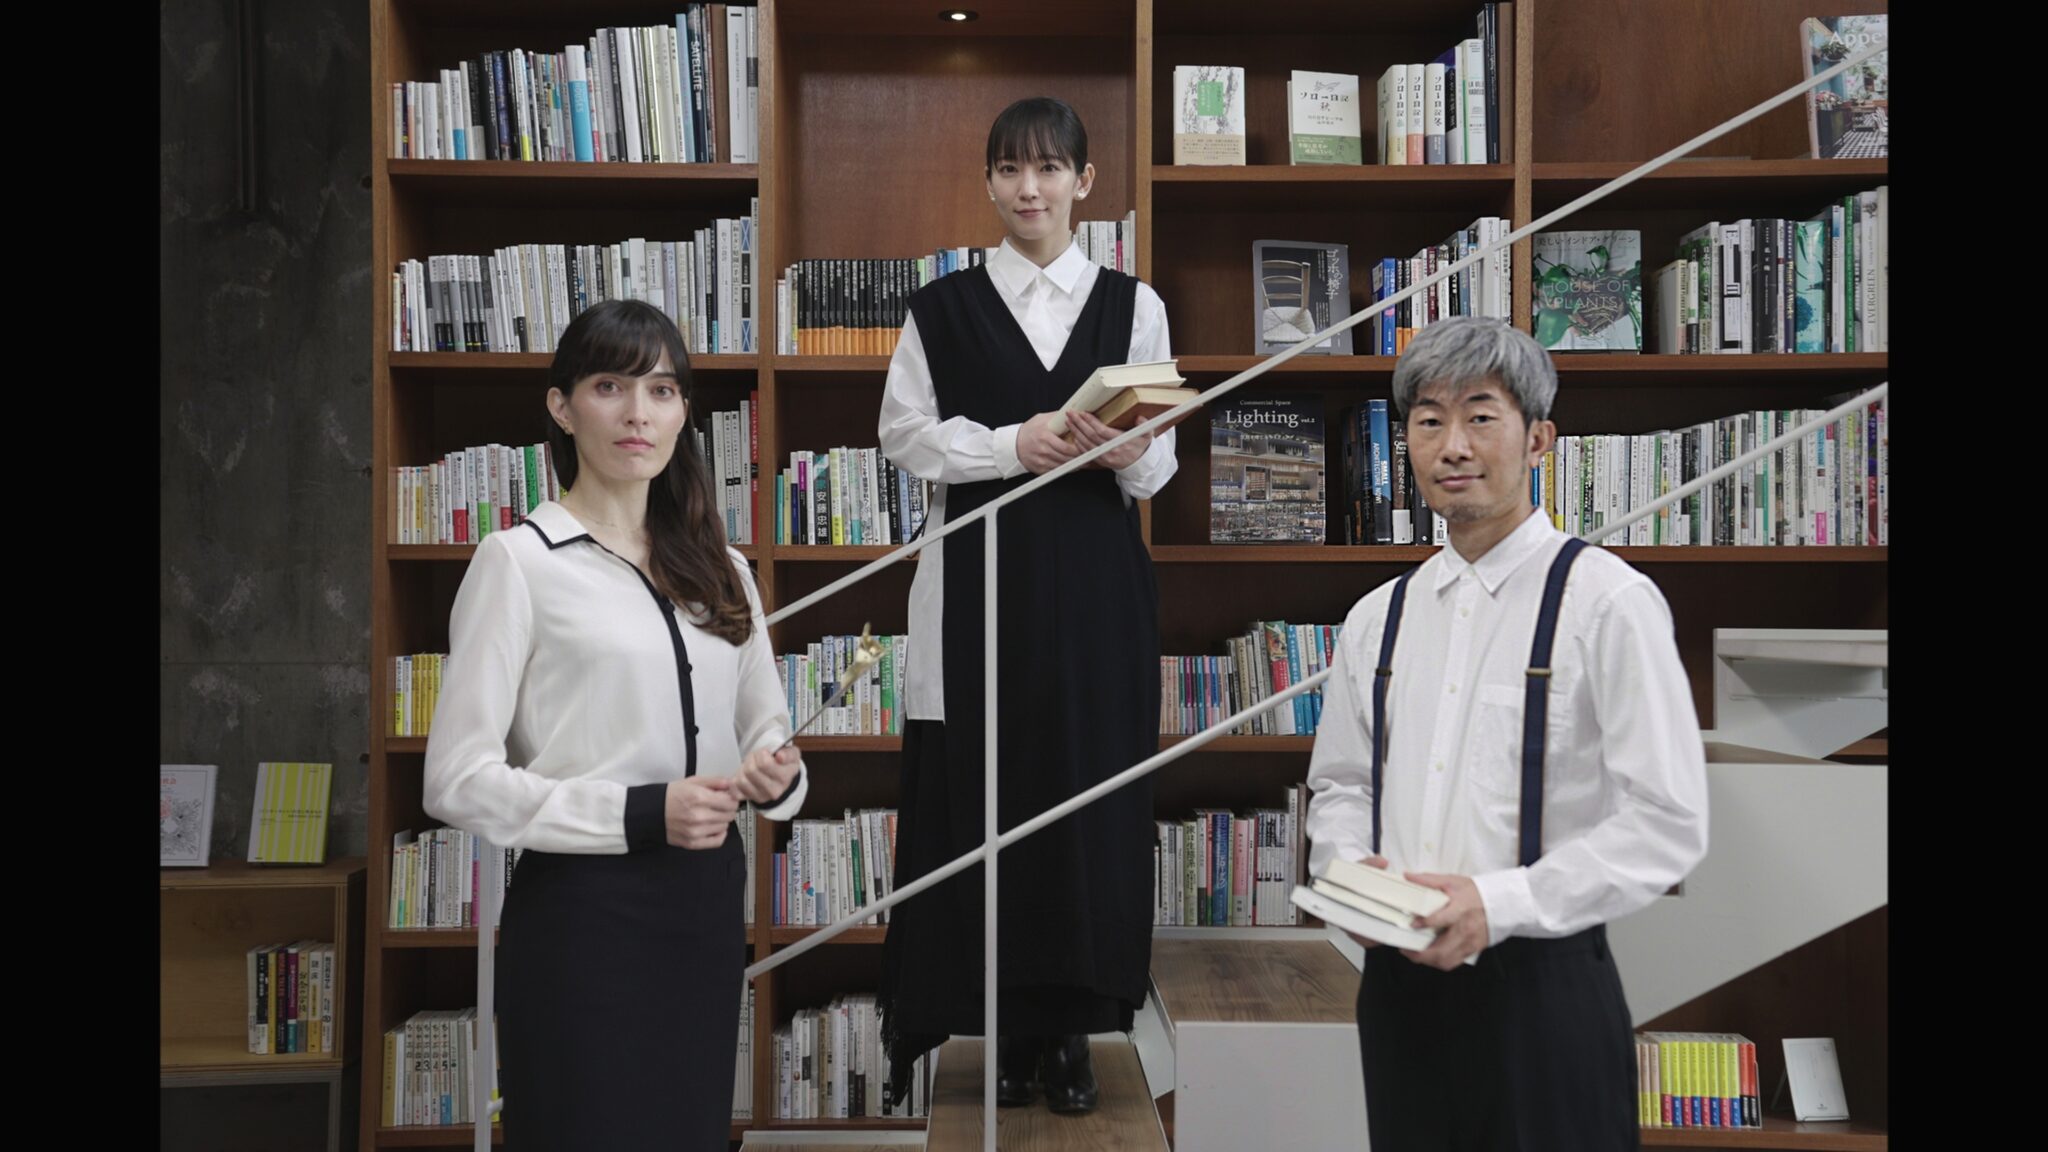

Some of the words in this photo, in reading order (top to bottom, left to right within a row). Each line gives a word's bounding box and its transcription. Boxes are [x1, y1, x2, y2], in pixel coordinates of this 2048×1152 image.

[689, 41, 703, 91] SATELLITE
[1325, 249, 1343, 300] ゴッホの椅子
[1542, 280, 1601, 293] HOUSE
[1607, 280, 1631, 292] OF
[1555, 296, 1617, 309] PLANTS
[1866, 268, 1876, 324] EVERGREEN
[1225, 410, 1299, 428] Lighting
[1381, 460, 1389, 485] SMALL
[816, 491, 828, 537] 安藤忠雄
